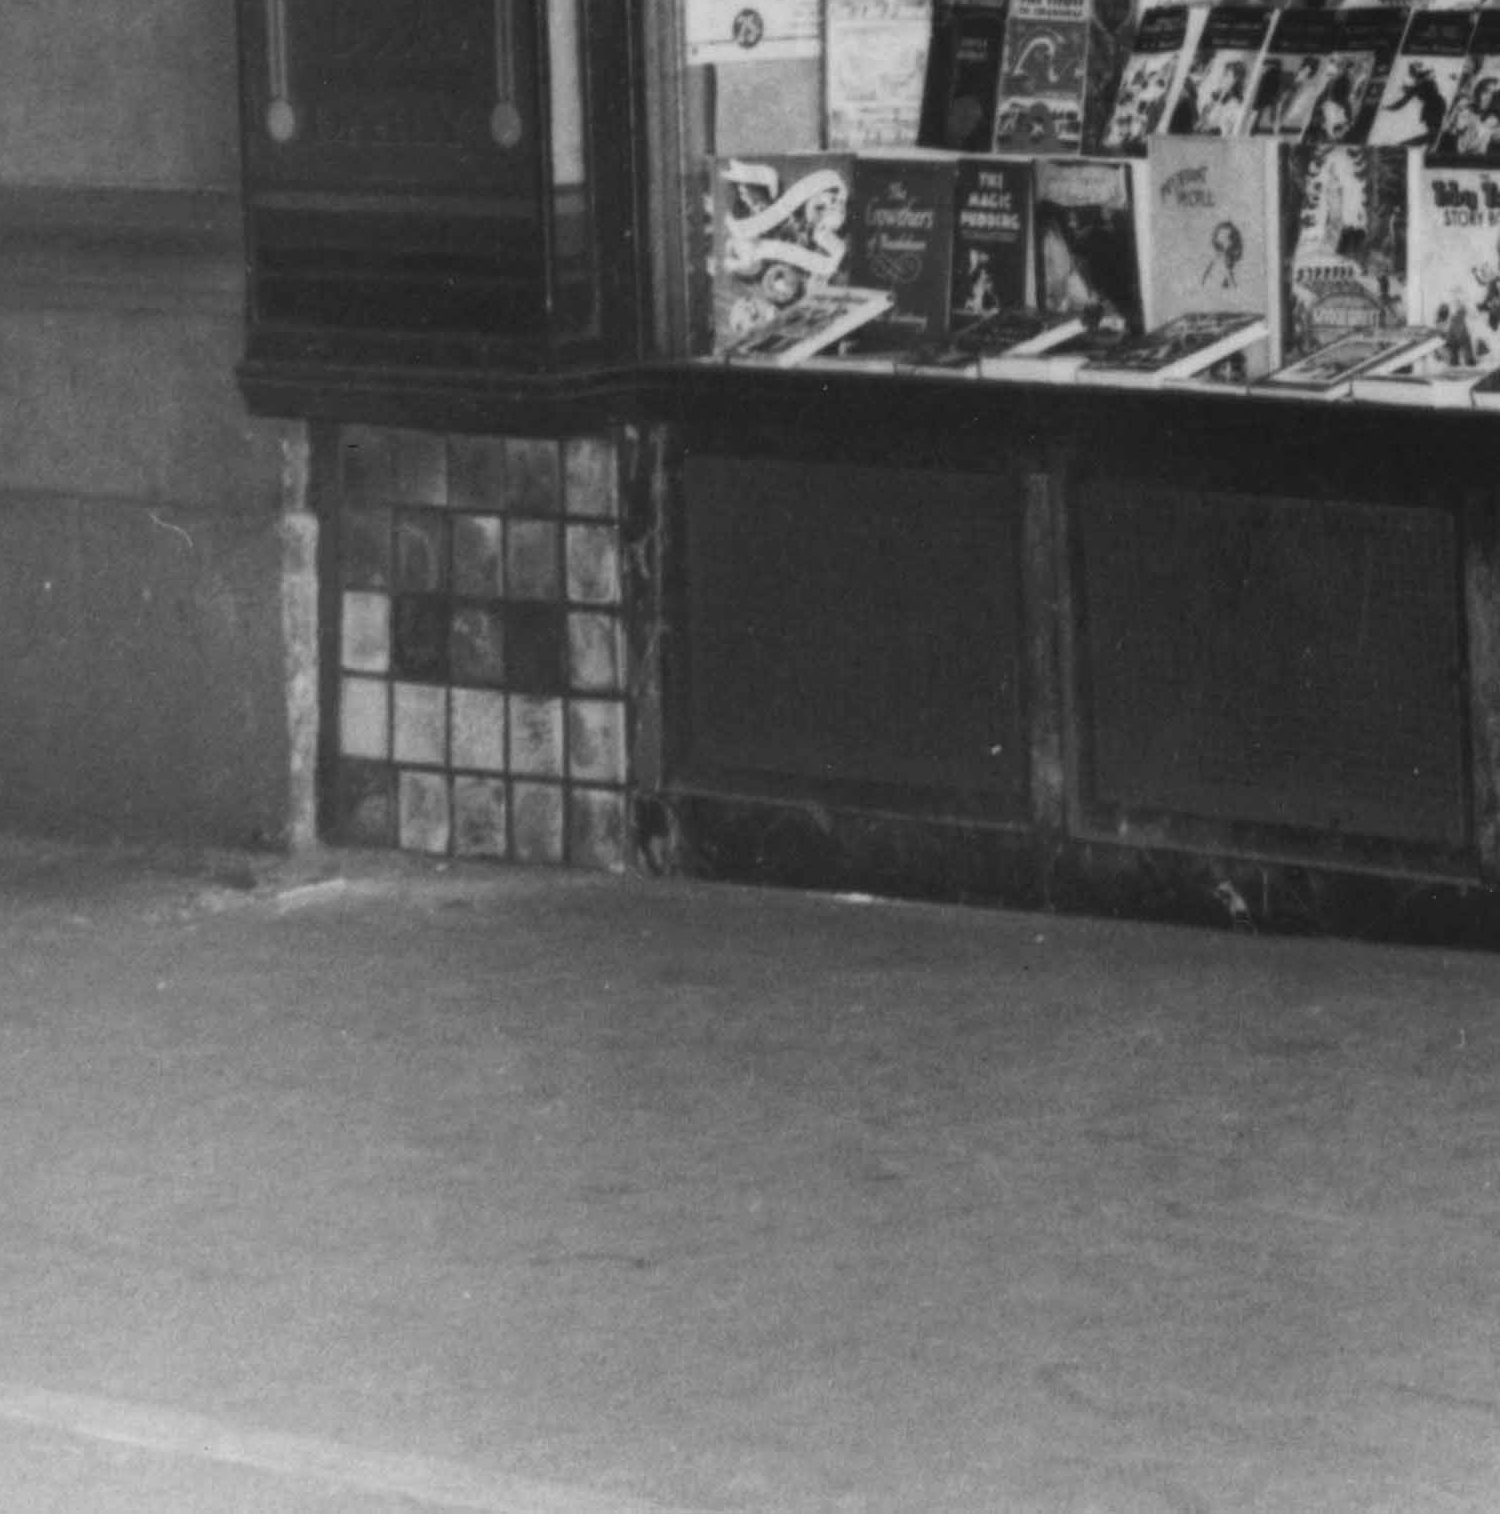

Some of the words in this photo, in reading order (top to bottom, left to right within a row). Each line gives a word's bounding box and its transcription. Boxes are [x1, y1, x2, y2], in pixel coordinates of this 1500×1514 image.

[978, 171, 1004, 189] THE
[967, 191, 1013, 209] MAGIC
[960, 210, 1021, 231] PUDDING
[1444, 209, 1483, 227] STORY
